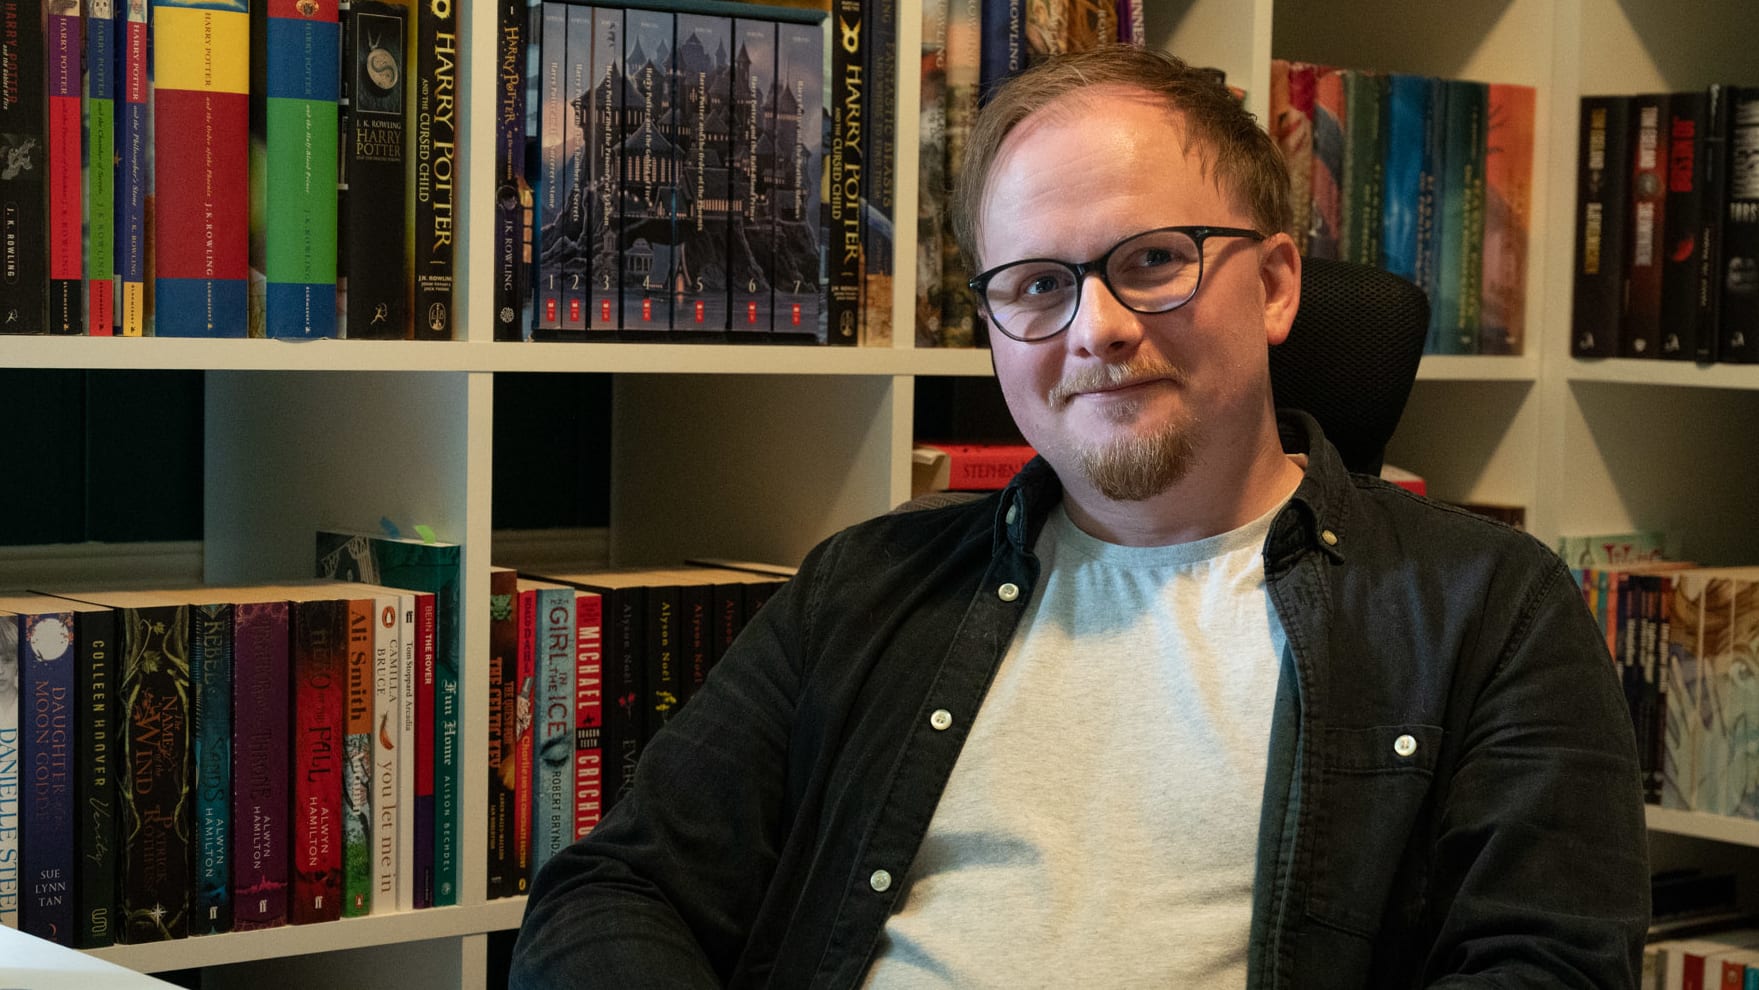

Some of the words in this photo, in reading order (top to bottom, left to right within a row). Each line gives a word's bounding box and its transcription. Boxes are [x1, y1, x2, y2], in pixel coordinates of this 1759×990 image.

[6, 3, 17, 46] HARRY
[97, 22, 105, 54] HARRY
[132, 25, 140, 60] HARRY
[204, 12, 212, 46] HARRY
[304, 22, 312, 52] HARRY
[936, 0, 946, 68] OWLING
[1009, 0, 1020, 71] ROWLING
[503, 26, 520, 72] HARRY
[7, 53, 18, 104] POTTER
[97, 58, 105, 97] POTTER
[132, 63, 140, 100] POTTER
[304, 55, 312, 95] POTTER
[434, 31, 455, 131] HARRY
[549, 62, 558, 86] Harry
[574, 63, 583, 87] Harry
[604, 65, 613, 90] Harry
[644, 67, 653, 91] Harry
[698, 73, 706, 95] Harry
[750, 76, 759, 98] Harry
[882, 42, 895, 136] FANTASTIC
[503, 73, 520, 124] POTTER
[604, 91, 613, 113] Potter
[645, 92, 653, 118] Potter
[698, 96, 706, 121] Potter
[844, 63, 863, 159] HARRY
[356, 128, 401, 144] HARRY
[371, 120, 401, 129] ROWLING
[419, 112, 430, 160] CURSED
[604, 114, 612, 131] and
[131, 133, 140, 184] Philosopher's
[356, 143, 401, 157] POTTER
[604, 148, 612, 180] Prisoner
[831, 138, 843, 182] CURSED
[419, 163, 430, 202] CHILD
[874, 171, 883, 201] THEM
[882, 142, 894, 208] BEASTS
[131, 185, 139, 206] Stone
[434, 139, 455, 253] POTTER
[572, 193, 581, 221] Secrets
[831, 184, 843, 220] CHILD
[843, 163, 862, 265] POTTER
[6, 220, 14, 230] K.
[6, 234, 14, 277] ROWLING
[503, 238, 514, 291] ROWLING
[549, 275, 554, 290] 1
[571, 275, 579, 290] 2
[602, 275, 610, 290] 3
[642, 275, 651, 291] 4
[696, 275, 704, 291] 5
[748, 277, 756, 293] 6
[792, 280, 801, 295] 7
[351, 611, 368, 642] Ali
[424, 605, 433, 631] BEHN
[549, 606, 569, 665] GIRL
[621, 604, 633, 648] Alyson
[659, 602, 672, 647] Alyson
[692, 604, 704, 648] Alyson
[725, 600, 736, 645] Alyson
[203, 621, 225, 685] REBEL
[309, 627, 333, 689] HERO
[405, 641, 413, 660] Tom
[424, 634, 433, 653] THE
[92, 640, 106, 712] COLLEEN
[351, 651, 367, 721] Smith
[376, 648, 387, 696] BRUCE
[388, 639, 398, 703] CAMILLA
[403, 660, 413, 698] Stoppard
[424, 653, 433, 685] ROVER
[490, 656, 503, 685] THE
[548, 667, 558, 692] THE
[559, 672, 568, 686] IN
[578, 625, 600, 710] MICHAEL
[660, 652, 672, 682] Noël
[441, 679, 457, 716] Fun
[503, 680, 514, 697] THE
[34, 680, 49, 744] MOON
[161, 694, 178, 748] NAME
[173, 714, 184, 730] The
[405, 700, 413, 732] Arcadia
[490, 688, 502, 736] CELTIC
[503, 699, 514, 725] QUEST
[547, 695, 568, 737] ICE
[51, 687, 67, 794] DAUGHTER
[92, 720, 106, 787] HOOVER
[134, 711, 161, 794] WIND
[306, 725, 333, 783] FALL
[441, 720, 457, 767] Home
[489, 739, 502, 769] KEY
[503, 728, 514, 745] FOR
[519, 735, 531, 775] Charlie
[0, 727, 17, 841] DANIELLE
[351, 751, 366, 816] Autumn
[377, 760, 394, 797] you
[442, 775, 452, 817] ALISON
[551, 771, 561, 811] ROBERT
[577, 755, 600, 837] CRICHTO
[87, 797, 111, 868] Verity
[309, 796, 320, 866] HAMILTON
[319, 807, 330, 854] ALWYN
[381, 804, 397, 828] let
[153, 813, 174, 882] PATRICK
[205, 807, 215, 878] HAMILTON
[215, 818, 226, 864] ALWYN
[252, 804, 262, 870] HAMILTON
[263, 815, 272, 858] ALWYN
[381, 837, 392, 867] me
[442, 822, 452, 873] BECHDEL
[549, 815, 561, 858] BRYNDZ
[0, 847, 17, 923] STEEL
[35, 882, 66, 894] LYNN
[40, 868, 61, 880] SUE
[381, 874, 397, 893] in
[39, 896, 62, 907] TAN
